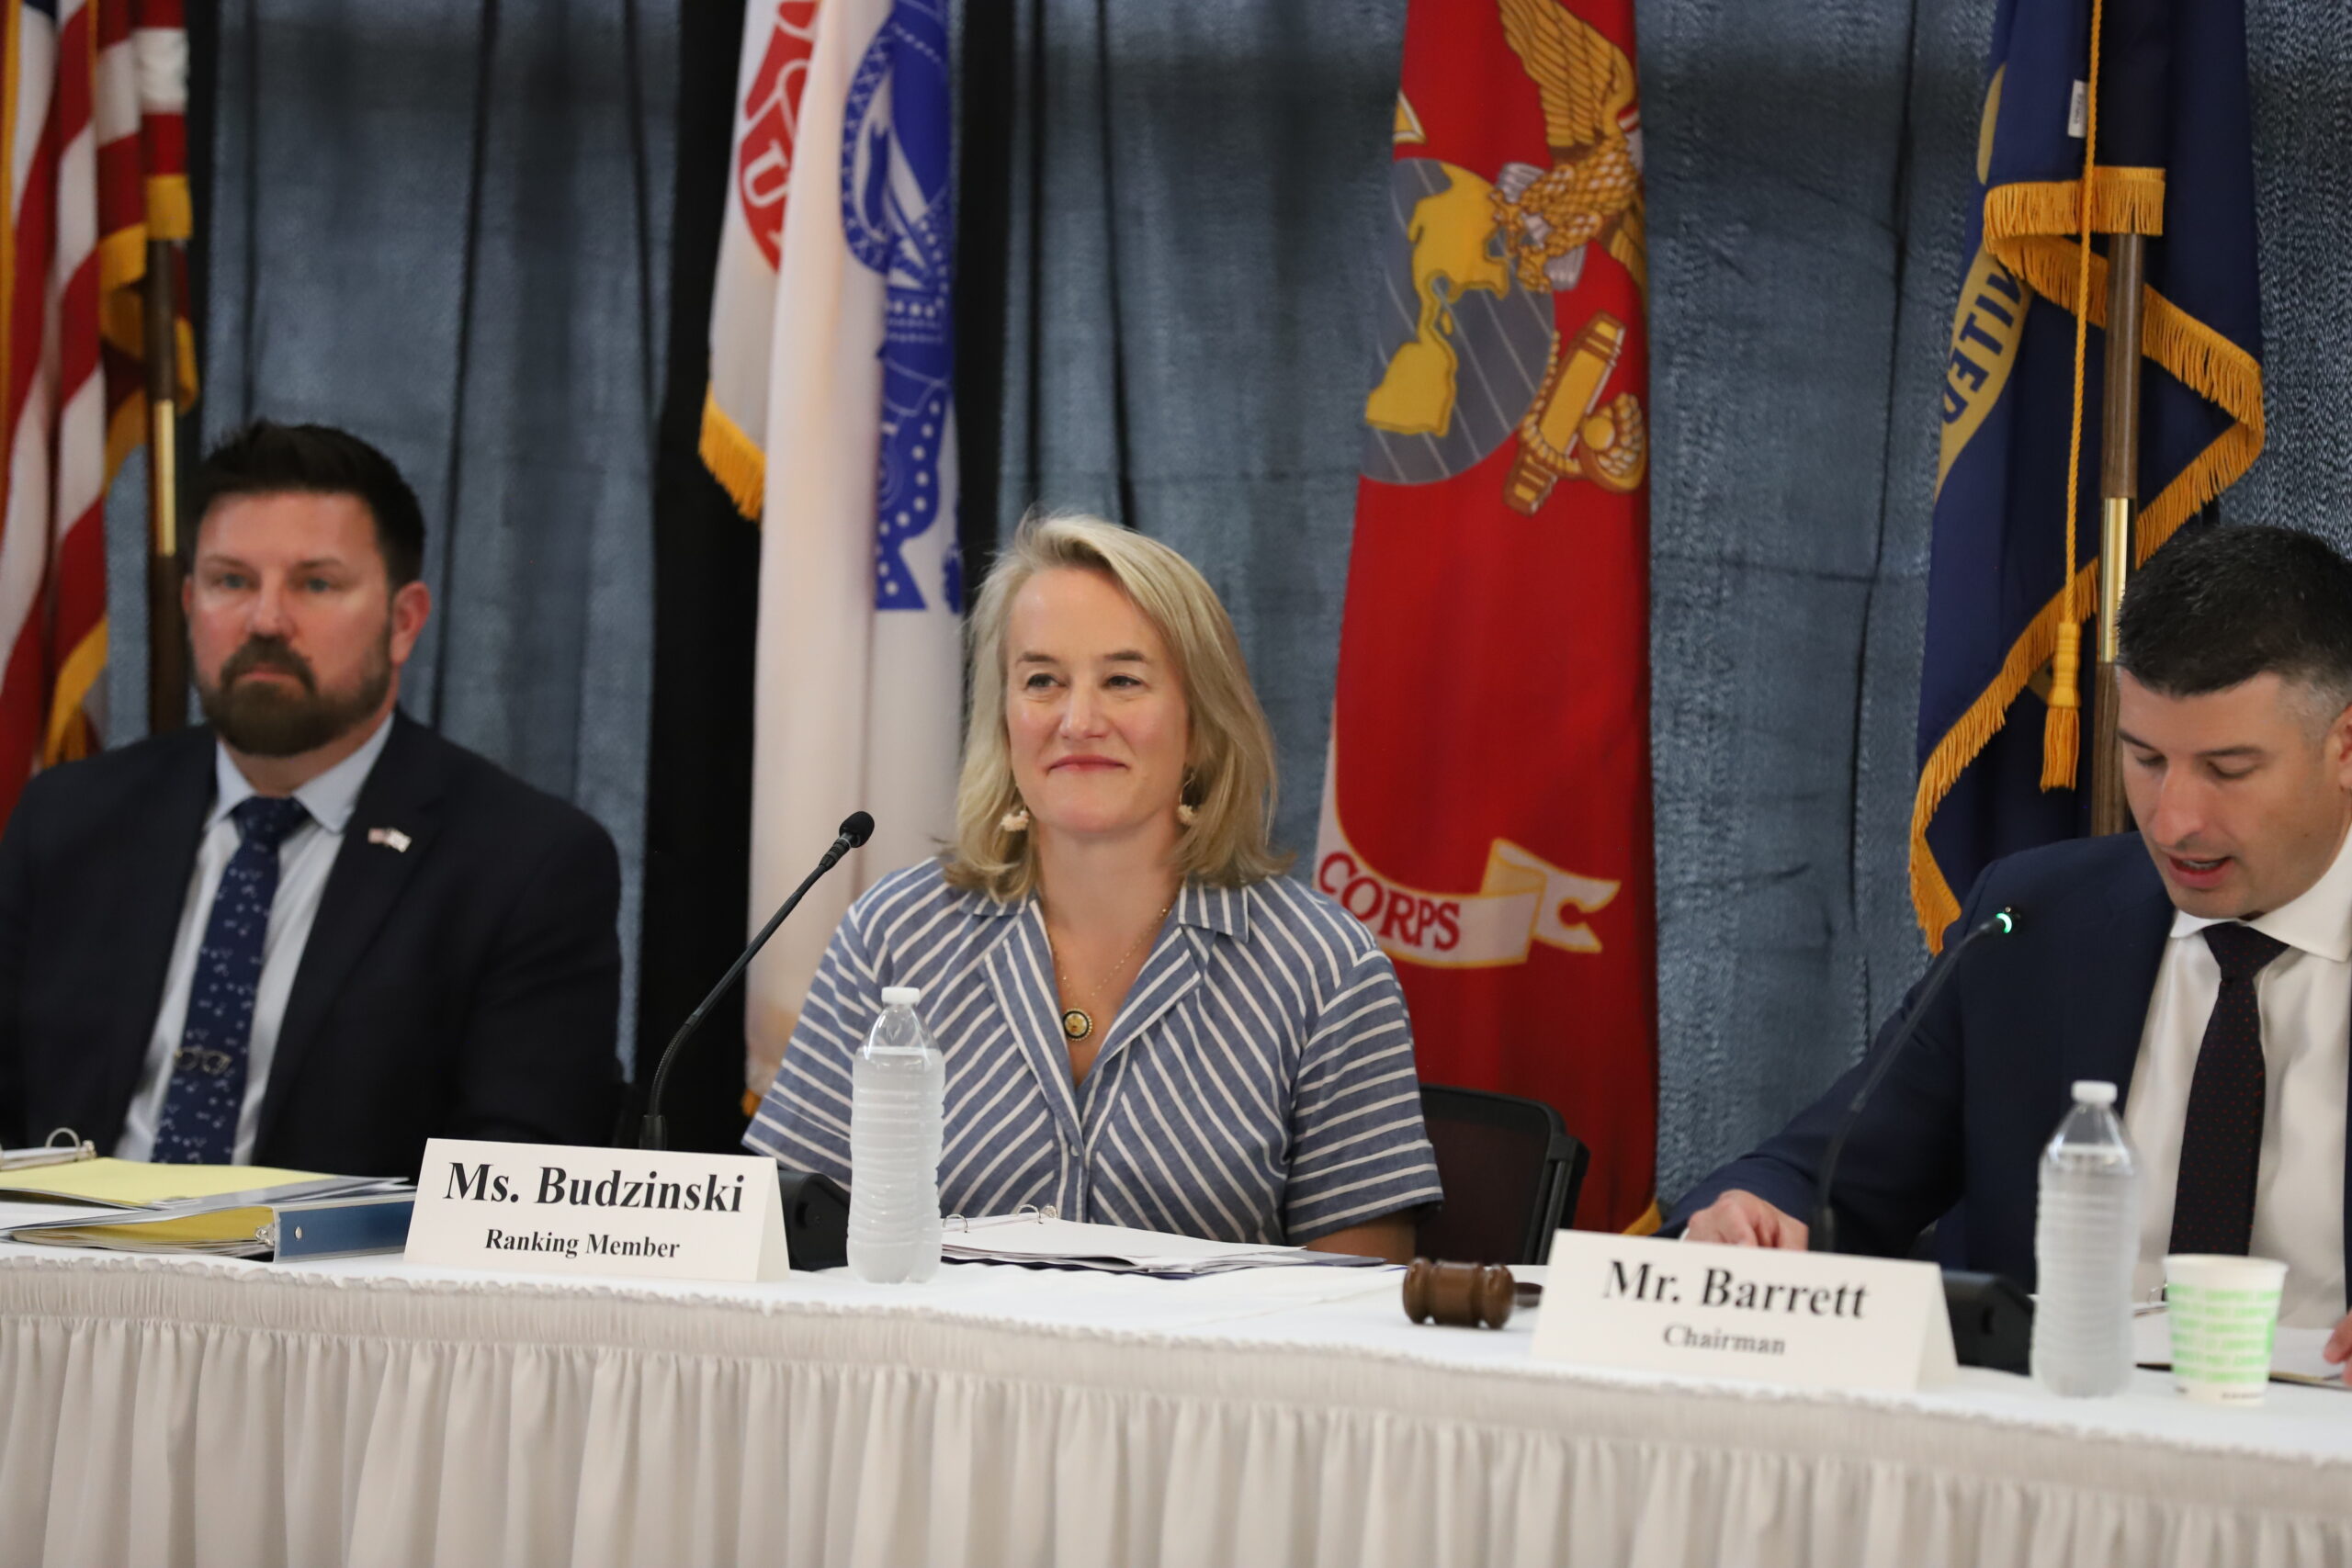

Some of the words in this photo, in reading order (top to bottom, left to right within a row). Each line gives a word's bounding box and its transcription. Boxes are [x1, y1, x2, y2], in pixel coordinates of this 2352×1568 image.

[1318, 852, 1461, 952] CORPS
[443, 1162, 519, 1203] Ms.
[535, 1166, 745, 1213] Budzinski
[485, 1229, 579, 1258] Ranking
[586, 1234, 681, 1258] Member
[1604, 1259, 1681, 1303] Mr.
[1700, 1268, 1869, 1319] Barrett
[1663, 1325, 1786, 1355] Chairman
